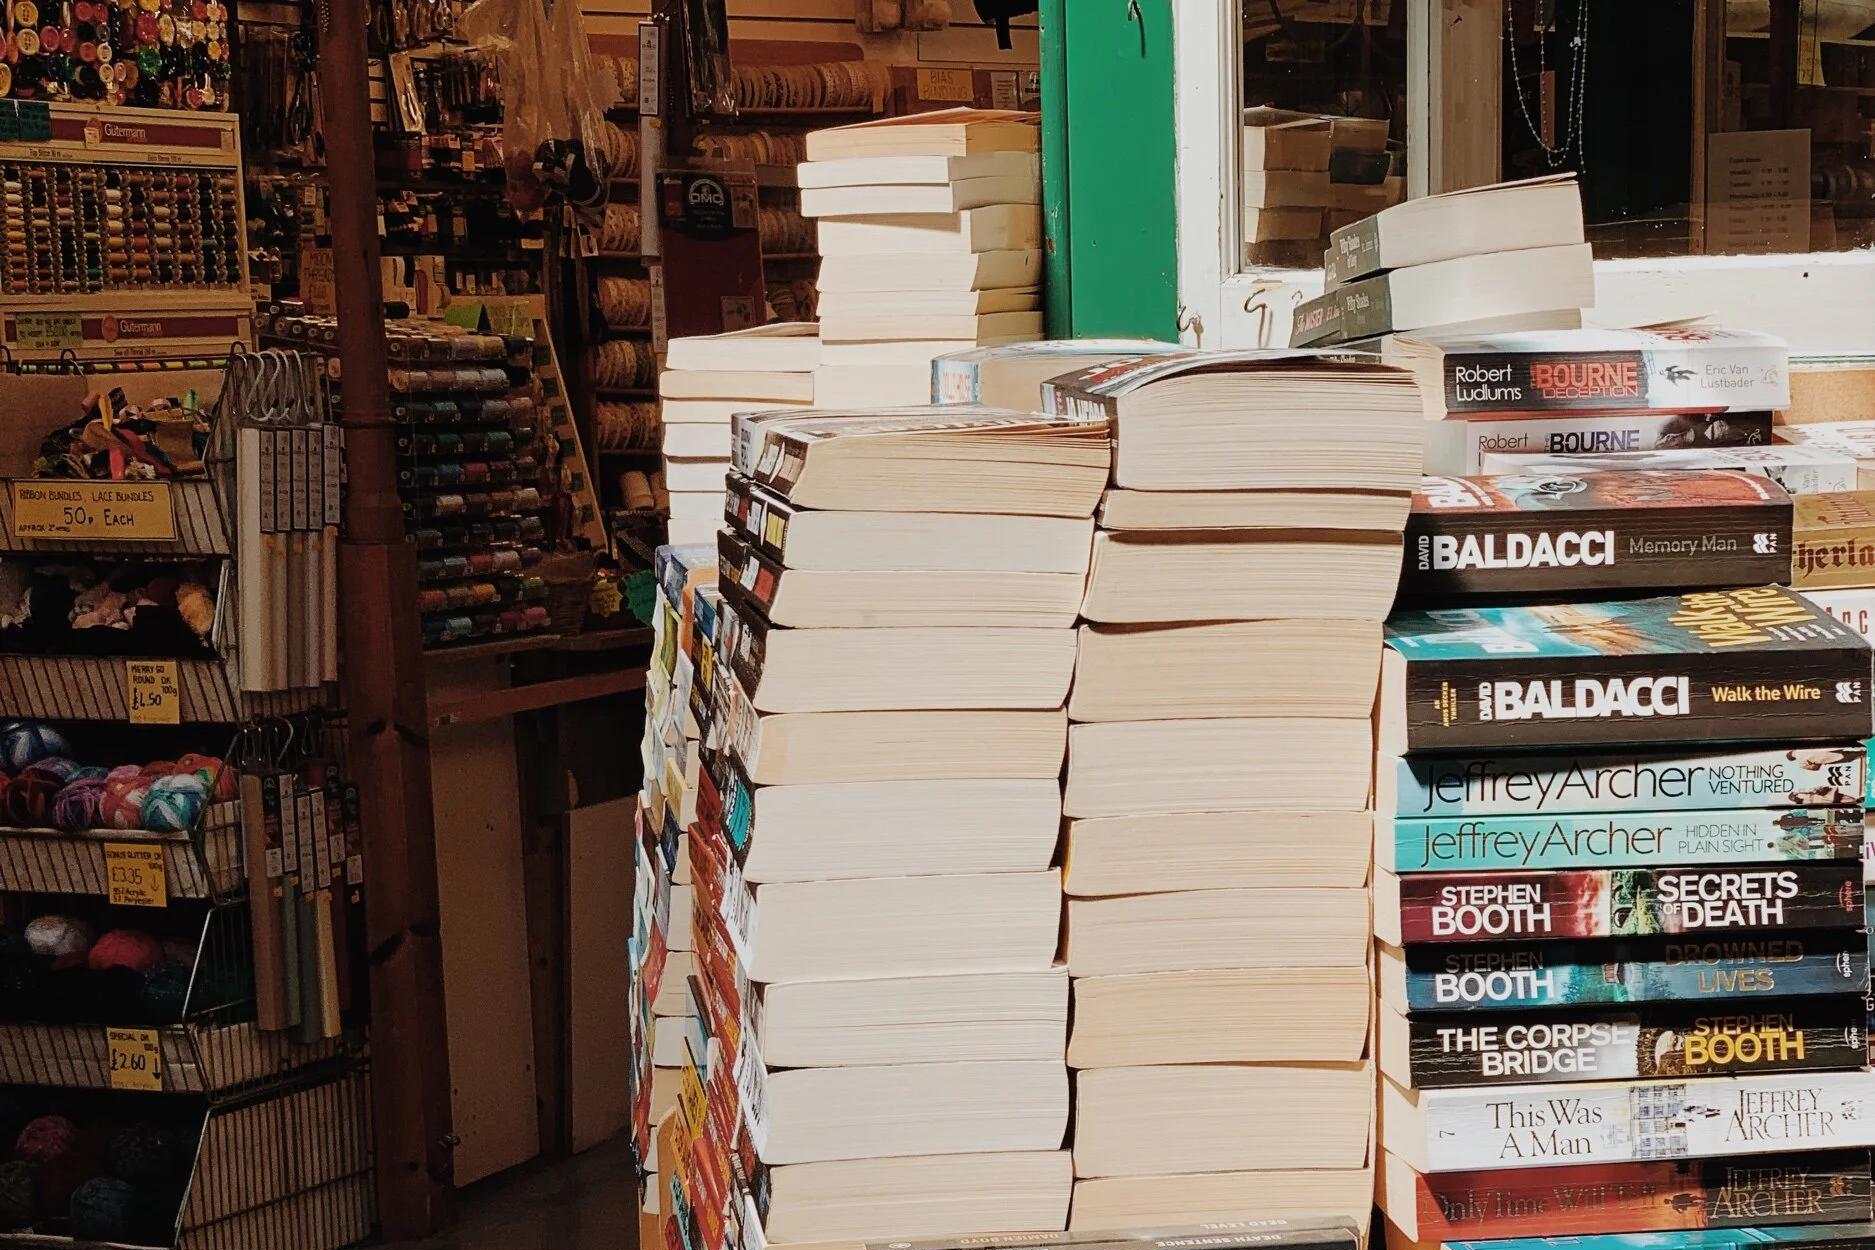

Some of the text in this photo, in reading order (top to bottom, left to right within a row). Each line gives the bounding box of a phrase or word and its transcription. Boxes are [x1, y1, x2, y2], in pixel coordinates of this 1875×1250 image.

[1455, 364, 1512, 383] Robert
[1537, 362, 1638, 388] BOURNE
[1706, 364, 1749, 375] Eric Van
[1543, 385, 1638, 399] DECEPTION
[1700, 377, 1755, 389] Lustbader
[1479, 430, 1640, 452] Robert BOURNE
[92, 491, 113, 501] LACE
[116, 491, 154, 502] BUNDLES
[1418, 535, 1430, 570] DAVID
[1434, 530, 1614, 570] BALDACCI
[1630, 536, 1737, 555] Memory Man
[1769, 533, 1777, 554] PAN
[1494, 676, 1690, 720] BALDACCI
[1712, 684, 1821, 702] Walk the Wire
[1853, 682, 1861, 702] PAN
[1709, 764, 1784, 780] NOTHING
[1844, 766, 1852, 786] PAN
[1424, 760, 1705, 813] Jeffrey Archer
[1709, 779, 1794, 795] VENTURED
[1686, 825, 1757, 839] HIDDEN IN
[1421, 822, 1673, 868] Jeffrey Archer
[1679, 838, 1763, 854] PLAIN SIGHT
[1441, 884, 1541, 906] STEPHEN
[1657, 871, 1799, 902] SECRETS
[1432, 904, 1551, 936] BOOTH
[1663, 899, 1783, 928] OF DEATH
[1445, 951, 1543, 973] STEPHEN
[1436, 970, 1555, 1003] BOOTH
[1698, 968, 1774, 992] LIVES
[1694, 1013, 1794, 1035] STEPHEN
[1437, 1023, 1634, 1052] THE CORPSE
[1685, 1031, 1805, 1065] BOOTH
[1482, 1048, 1598, 1076] BRIDGE
[1486, 1098, 1603, 1130] This Was
[1499, 1131, 1592, 1159] A Man
